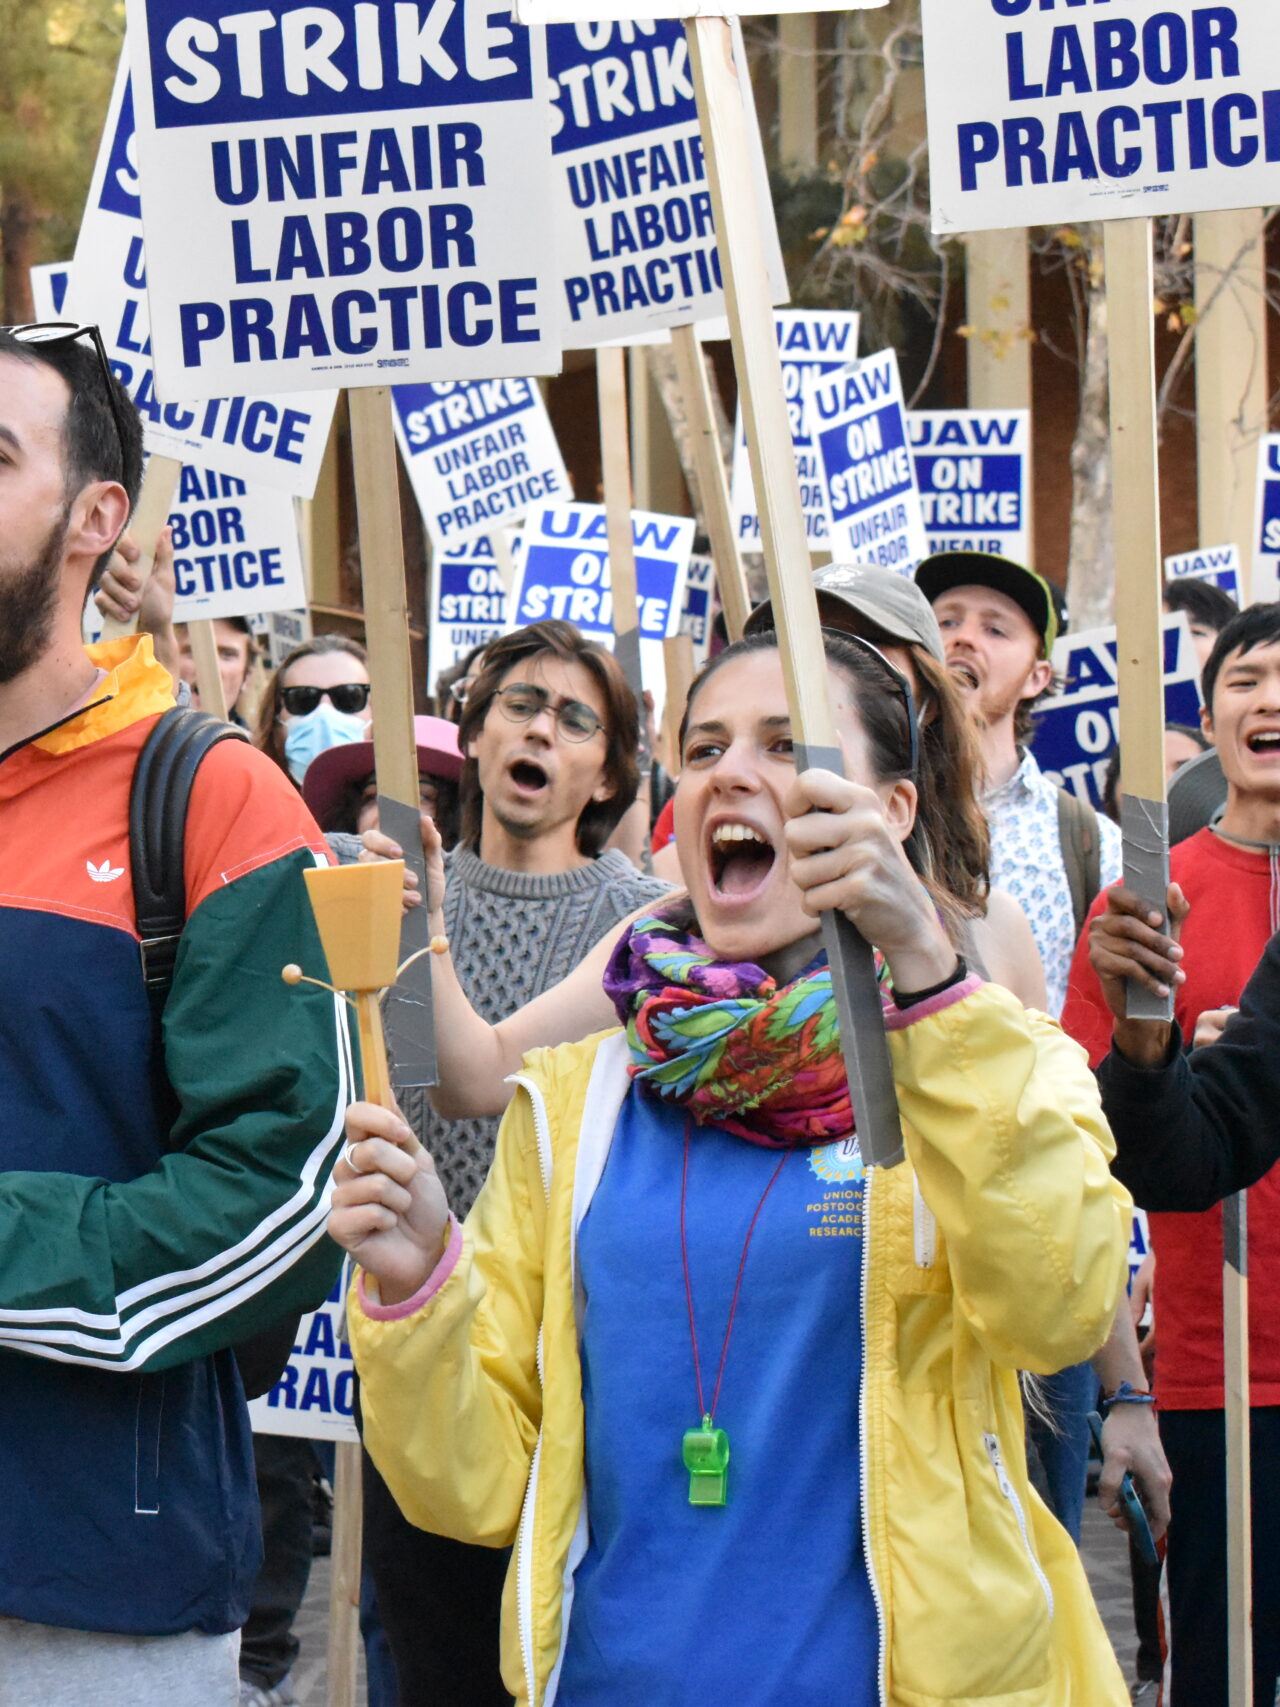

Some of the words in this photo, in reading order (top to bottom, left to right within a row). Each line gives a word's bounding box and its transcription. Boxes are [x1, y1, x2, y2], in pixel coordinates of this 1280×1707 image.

[164, 0, 518, 104] STRIKE
[1006, 6, 1240, 101] LABOR
[548, 37, 694, 137] STRIK
[211, 121, 486, 206] UNFAIR
[566, 135, 705, 208] UNFAIR
[231, 203, 477, 285] LABOR
[584, 191, 715, 262] LABOR
[564, 246, 723, 322] PRACTI
[179, 277, 541, 368] PRACTICE
[109, 358, 312, 464] ACTICE
[406, 378, 531, 445] STRIKE
[816, 362, 891, 420] UAW
[434, 422, 526, 476] UNFAIR
[847, 415, 882, 461] ON
[908, 419, 1018, 447] UAW
[179, 465, 246, 503] AIR
[447, 451, 531, 500] LABOR
[830, 446, 910, 512] STRIKE
[931, 457, 983, 490] ON
[437, 469, 560, 536] PRACTICE
[849, 504, 908, 549] UNFAIR
[920, 490, 1019, 525] TRIKE
[168, 506, 245, 550] BOR
[540, 510, 681, 551] UAW
[929, 539, 1002, 555] NFAIR
[174, 548, 285, 596] CTICE
[1173, 552, 1232, 575] UAW
[440, 595, 506, 621] STRI
[520, 585, 668, 632] STRIE
[806, 1202, 863, 1213] POSTDOC
[821, 1214, 862, 1224] ACADE
[823, 1190, 863, 1200] UNION
[809, 1227, 862, 1237] RESEARC
